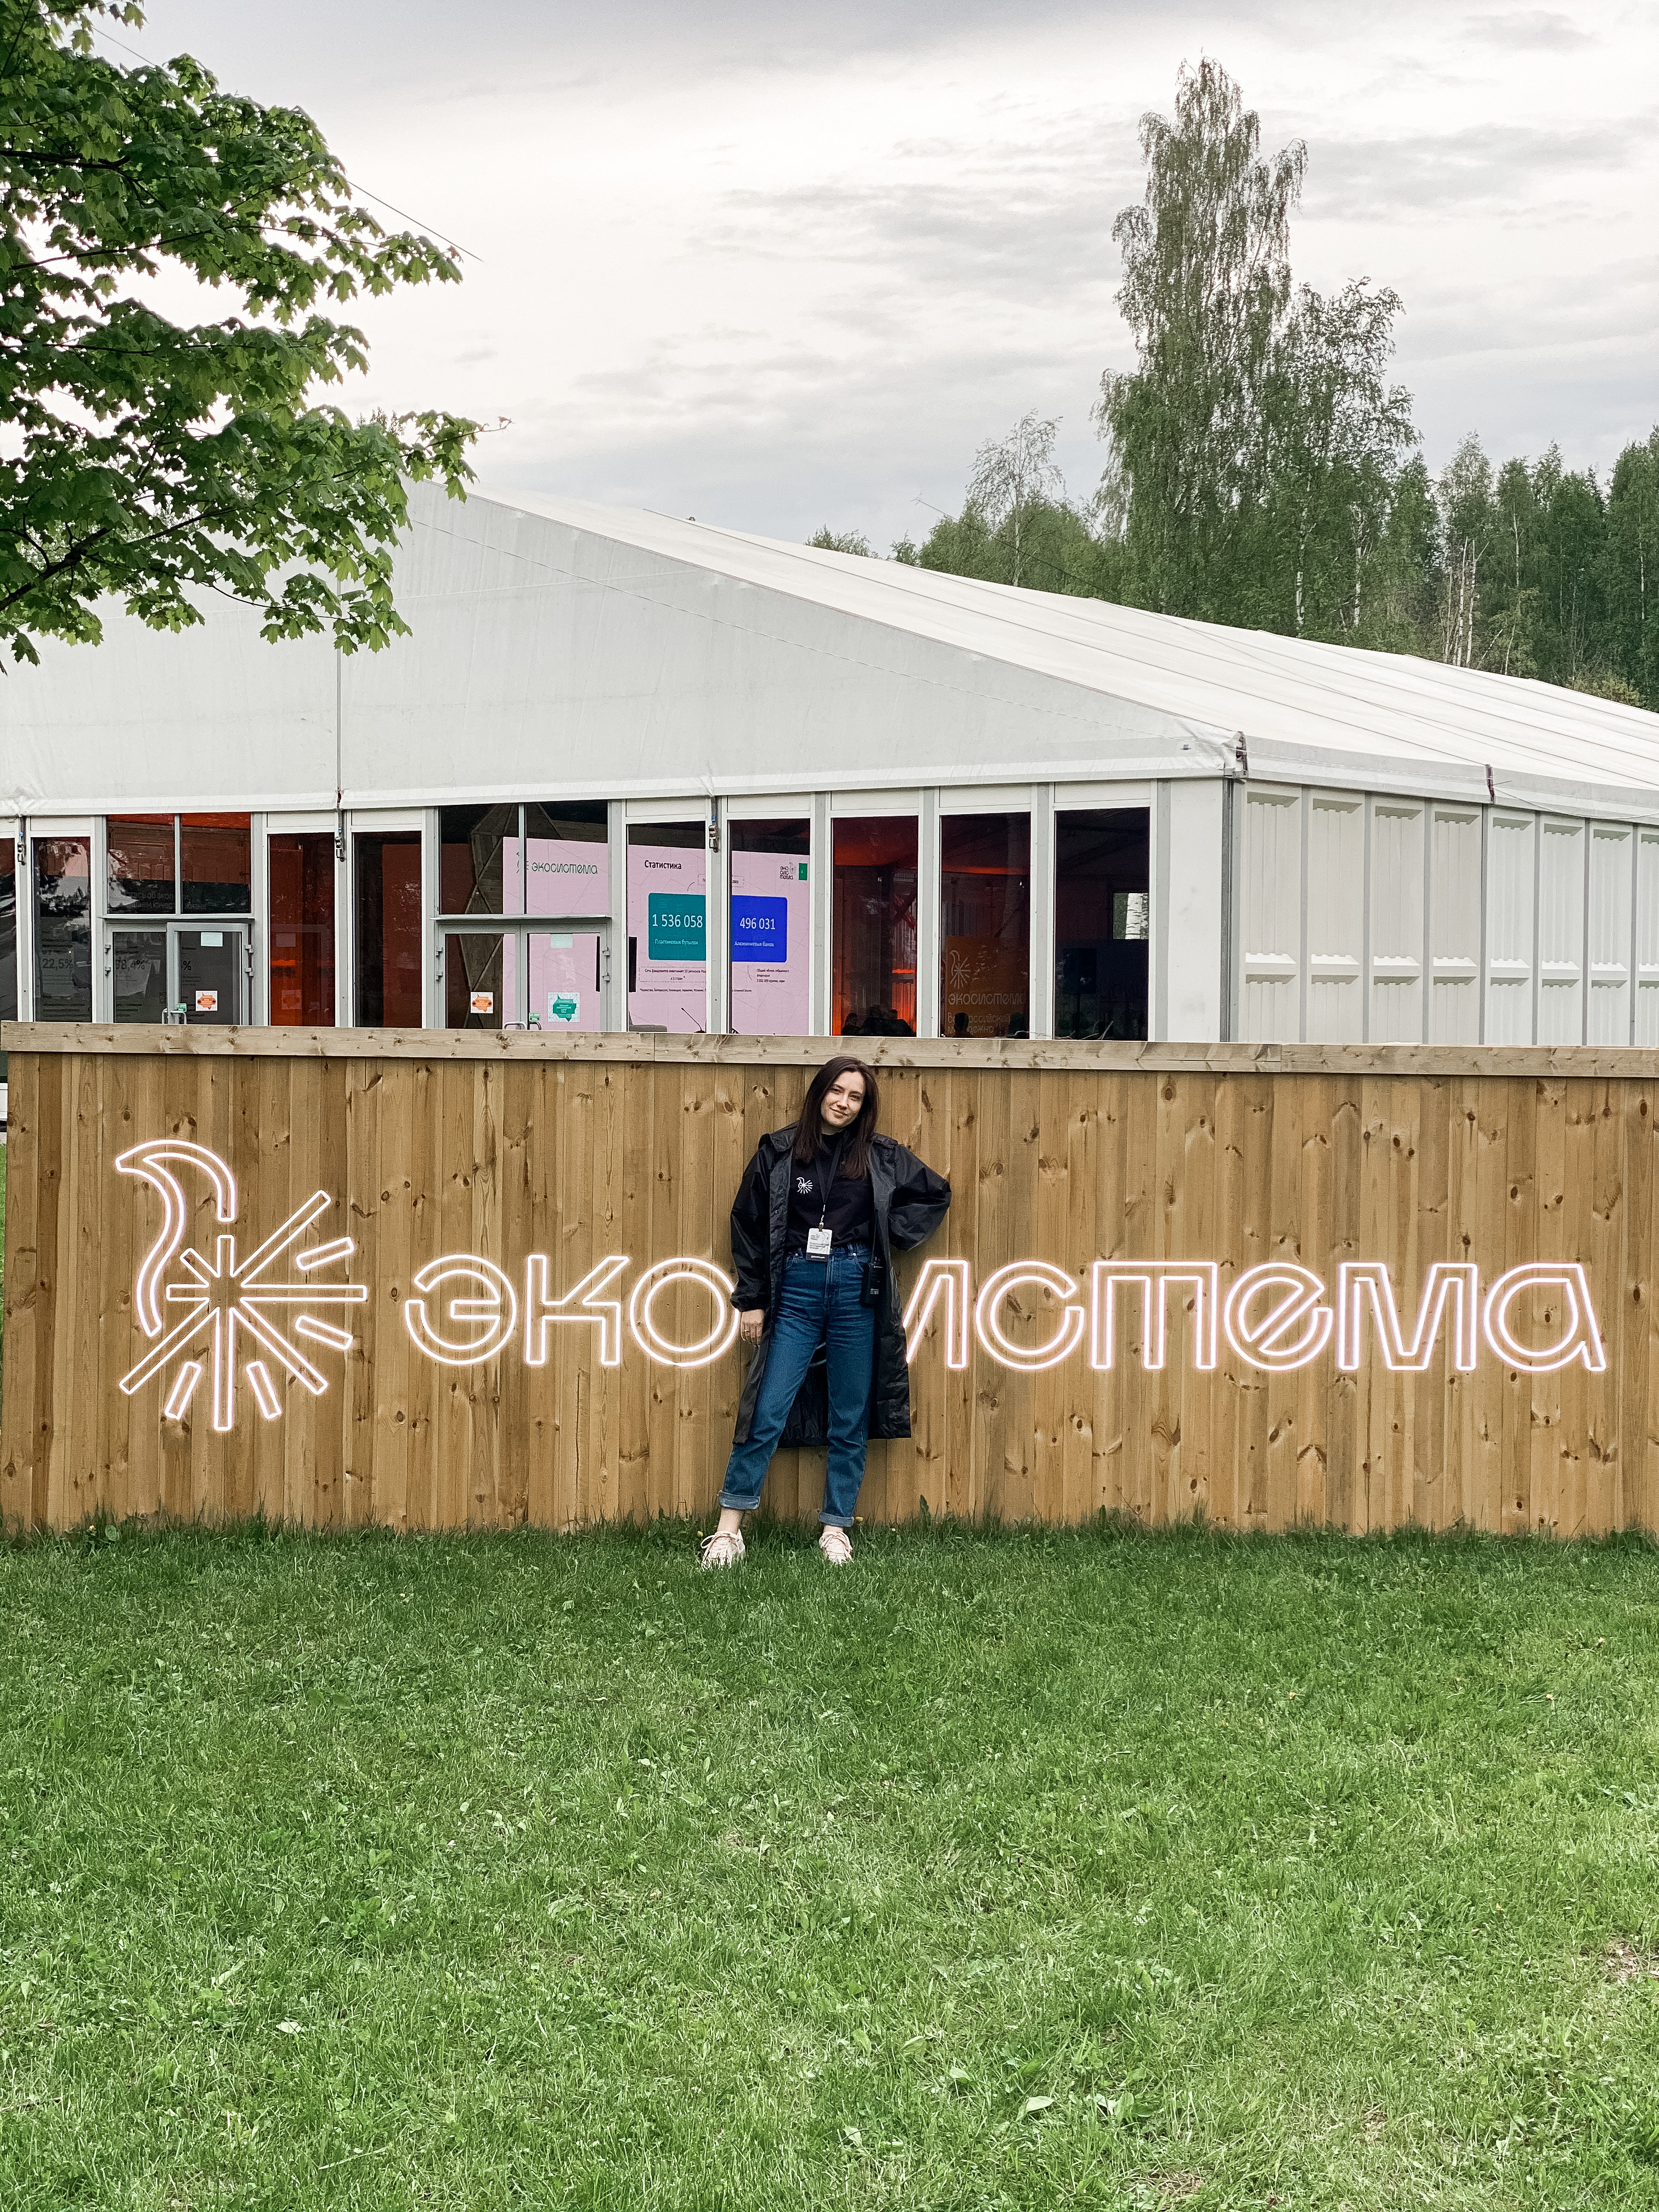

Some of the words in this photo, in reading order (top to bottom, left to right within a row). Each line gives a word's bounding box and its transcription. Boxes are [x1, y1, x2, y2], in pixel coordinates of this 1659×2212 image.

[644, 860, 682, 870] Статистика
[661, 915, 681, 928] 536
[684, 915, 703, 928] 058
[740, 918, 757, 930] 496
[759, 918, 776, 930] 031
[42, 958, 73, 970] 22,5%
